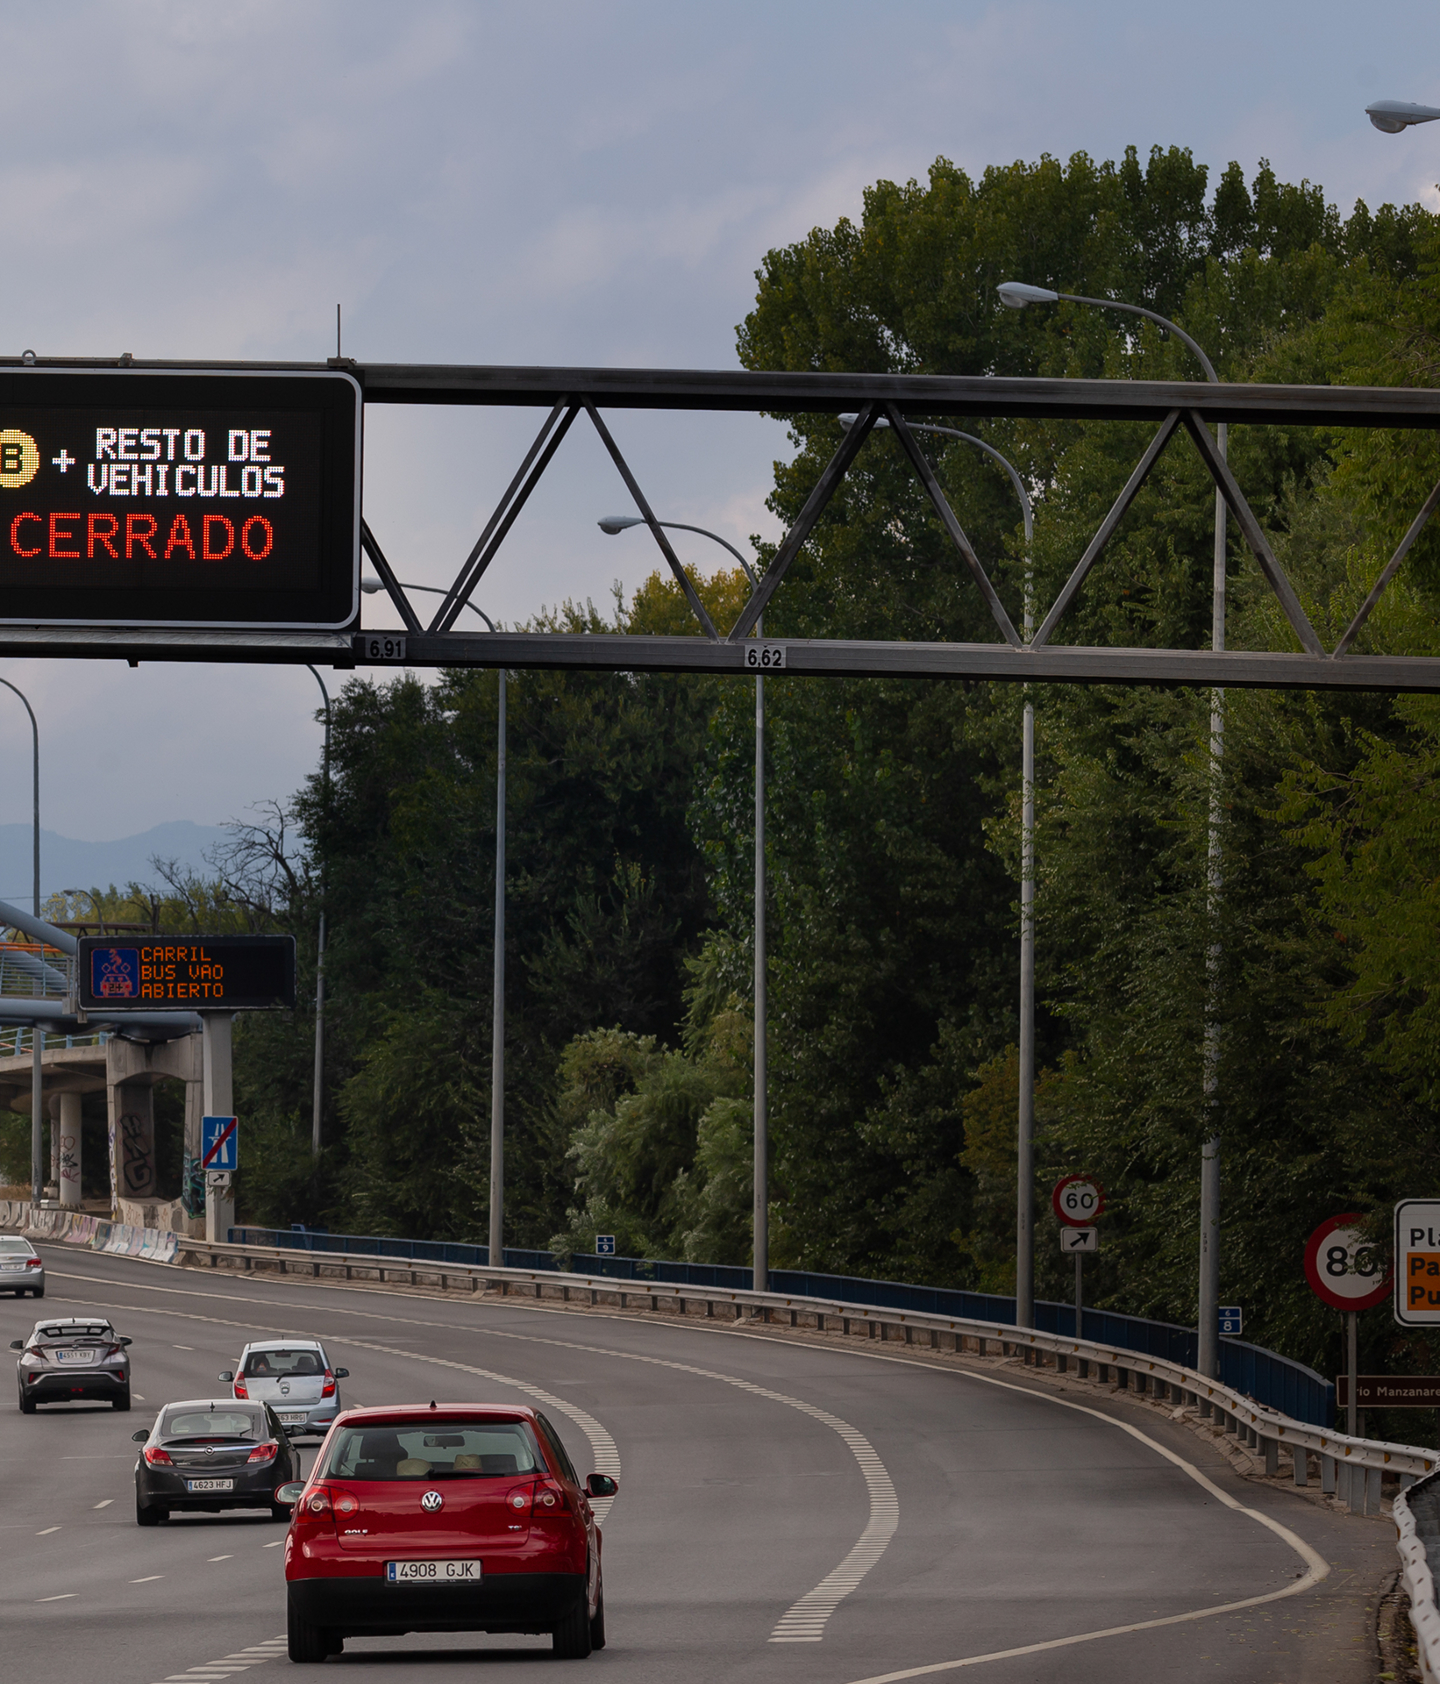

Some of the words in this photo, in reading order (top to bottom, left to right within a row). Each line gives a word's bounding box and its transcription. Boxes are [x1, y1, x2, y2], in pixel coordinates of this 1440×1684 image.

[95, 428, 206, 460] RESTO
[228, 429, 272, 462] DE
[0, 443, 23, 474] B
[87, 463, 285, 498] VEHICULOS
[10, 512, 273, 560] CERRADO
[370, 640, 402, 659] 6,91
[747, 648, 782, 667] 6,62
[141, 946, 211, 962] CARRIL
[141, 964, 176, 980] BUS
[188, 964, 224, 980] VAO
[141, 983, 224, 998] ABIERTO
[1066, 1193, 1094, 1209] 60
[1223, 1320, 1233, 1331] 8
[193, 1481, 214, 1489] 4623
[215, 1480, 232, 1488] HFJ
[400, 1563, 437, 1578] 4908
[446, 1562, 474, 1577] GJK
